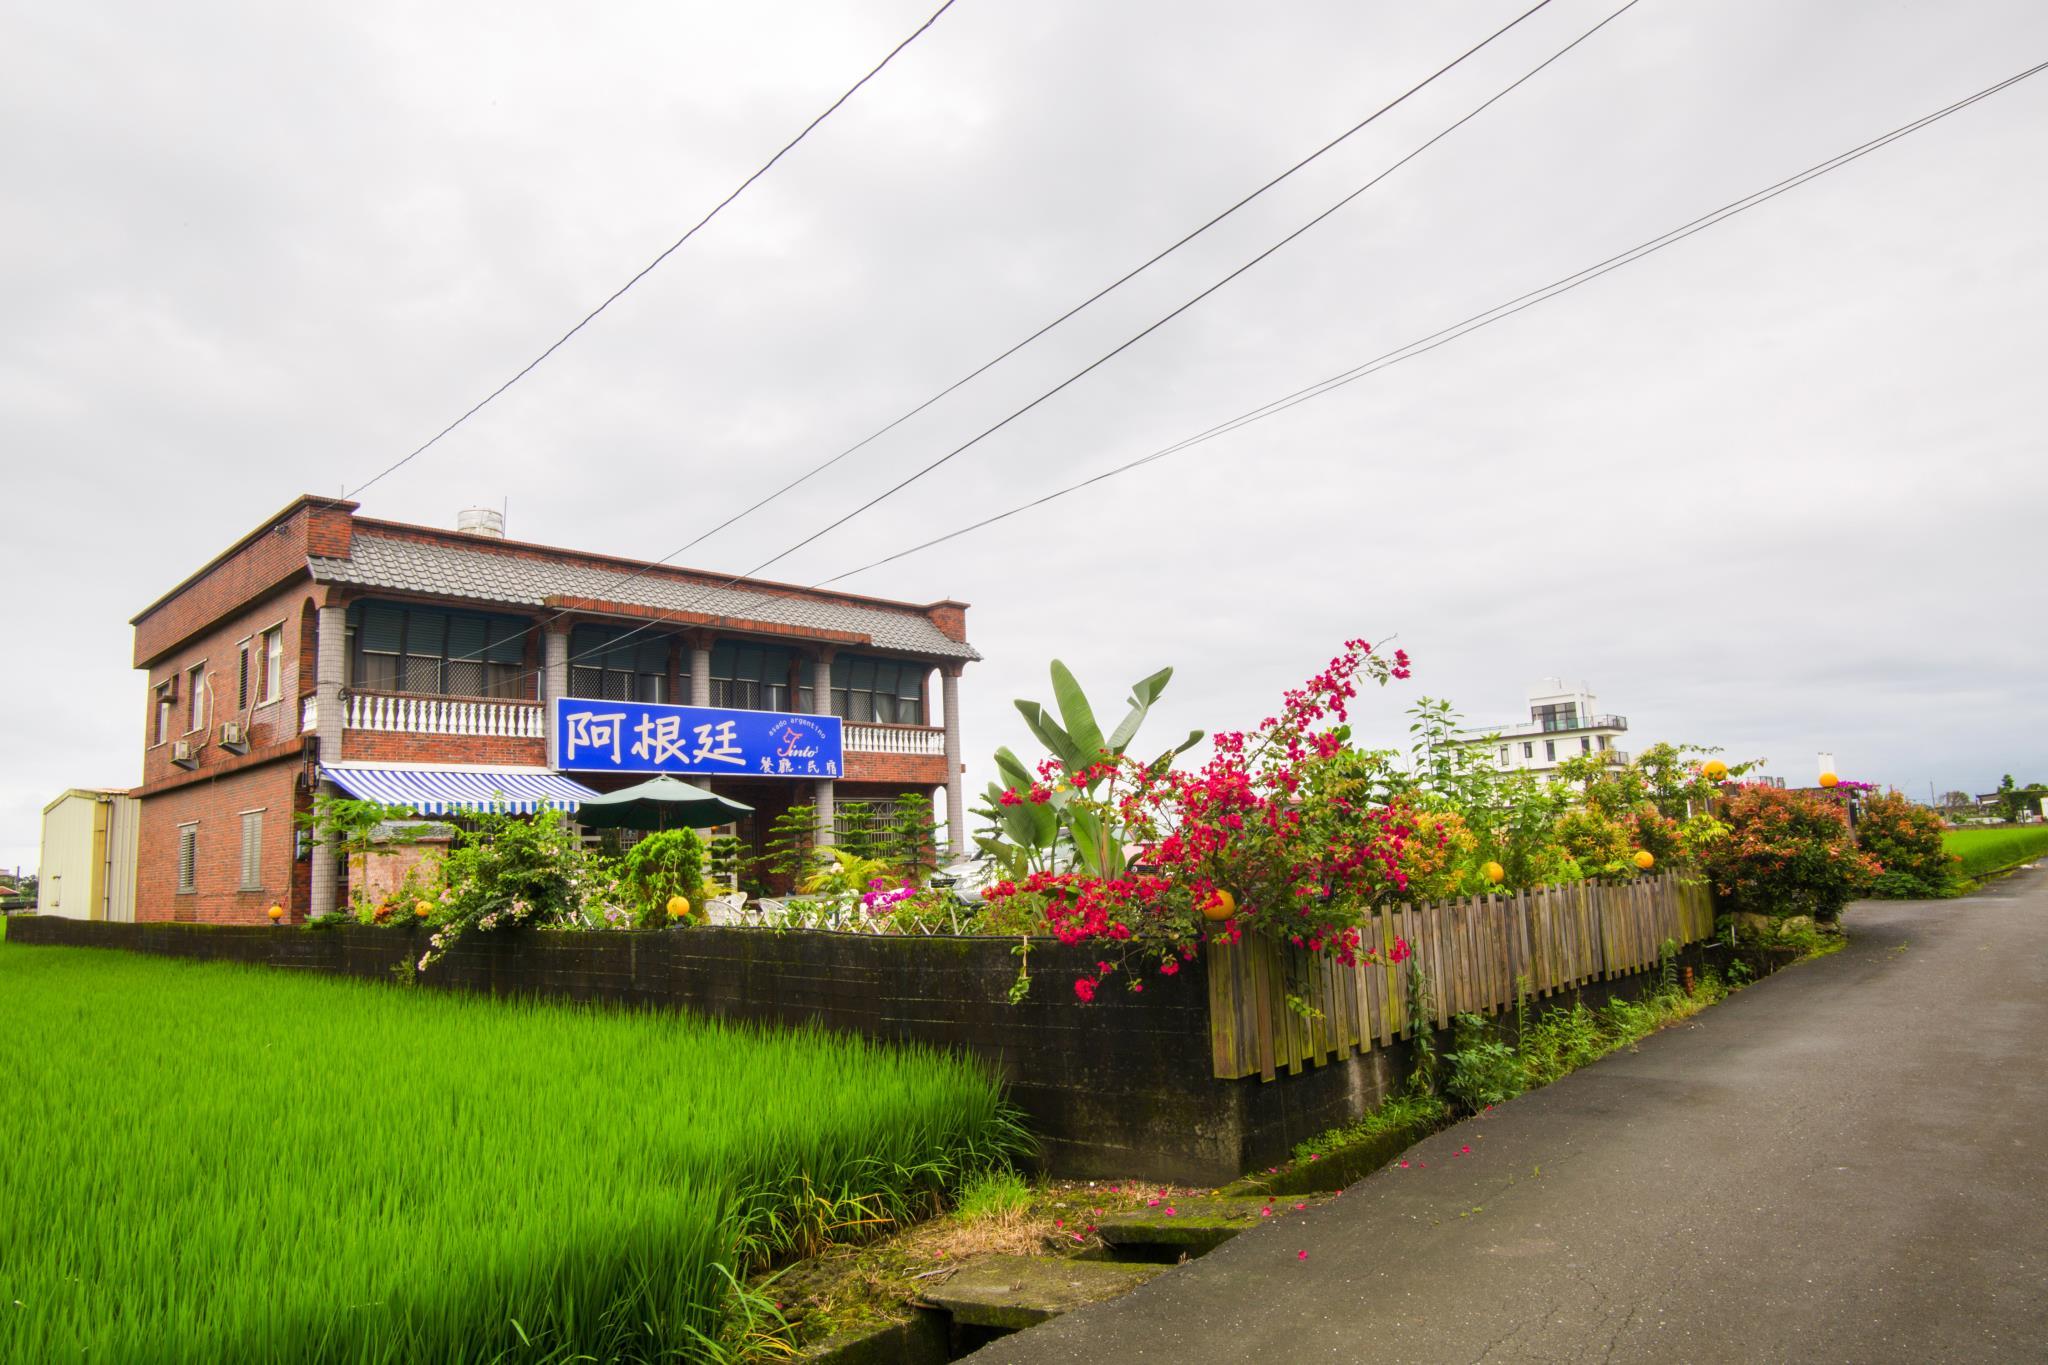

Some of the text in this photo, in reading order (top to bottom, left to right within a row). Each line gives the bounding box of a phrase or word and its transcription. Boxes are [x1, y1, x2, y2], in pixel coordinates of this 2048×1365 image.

[566, 711, 746, 765] 阿根廷
[768, 717, 826, 739] asado argentino
